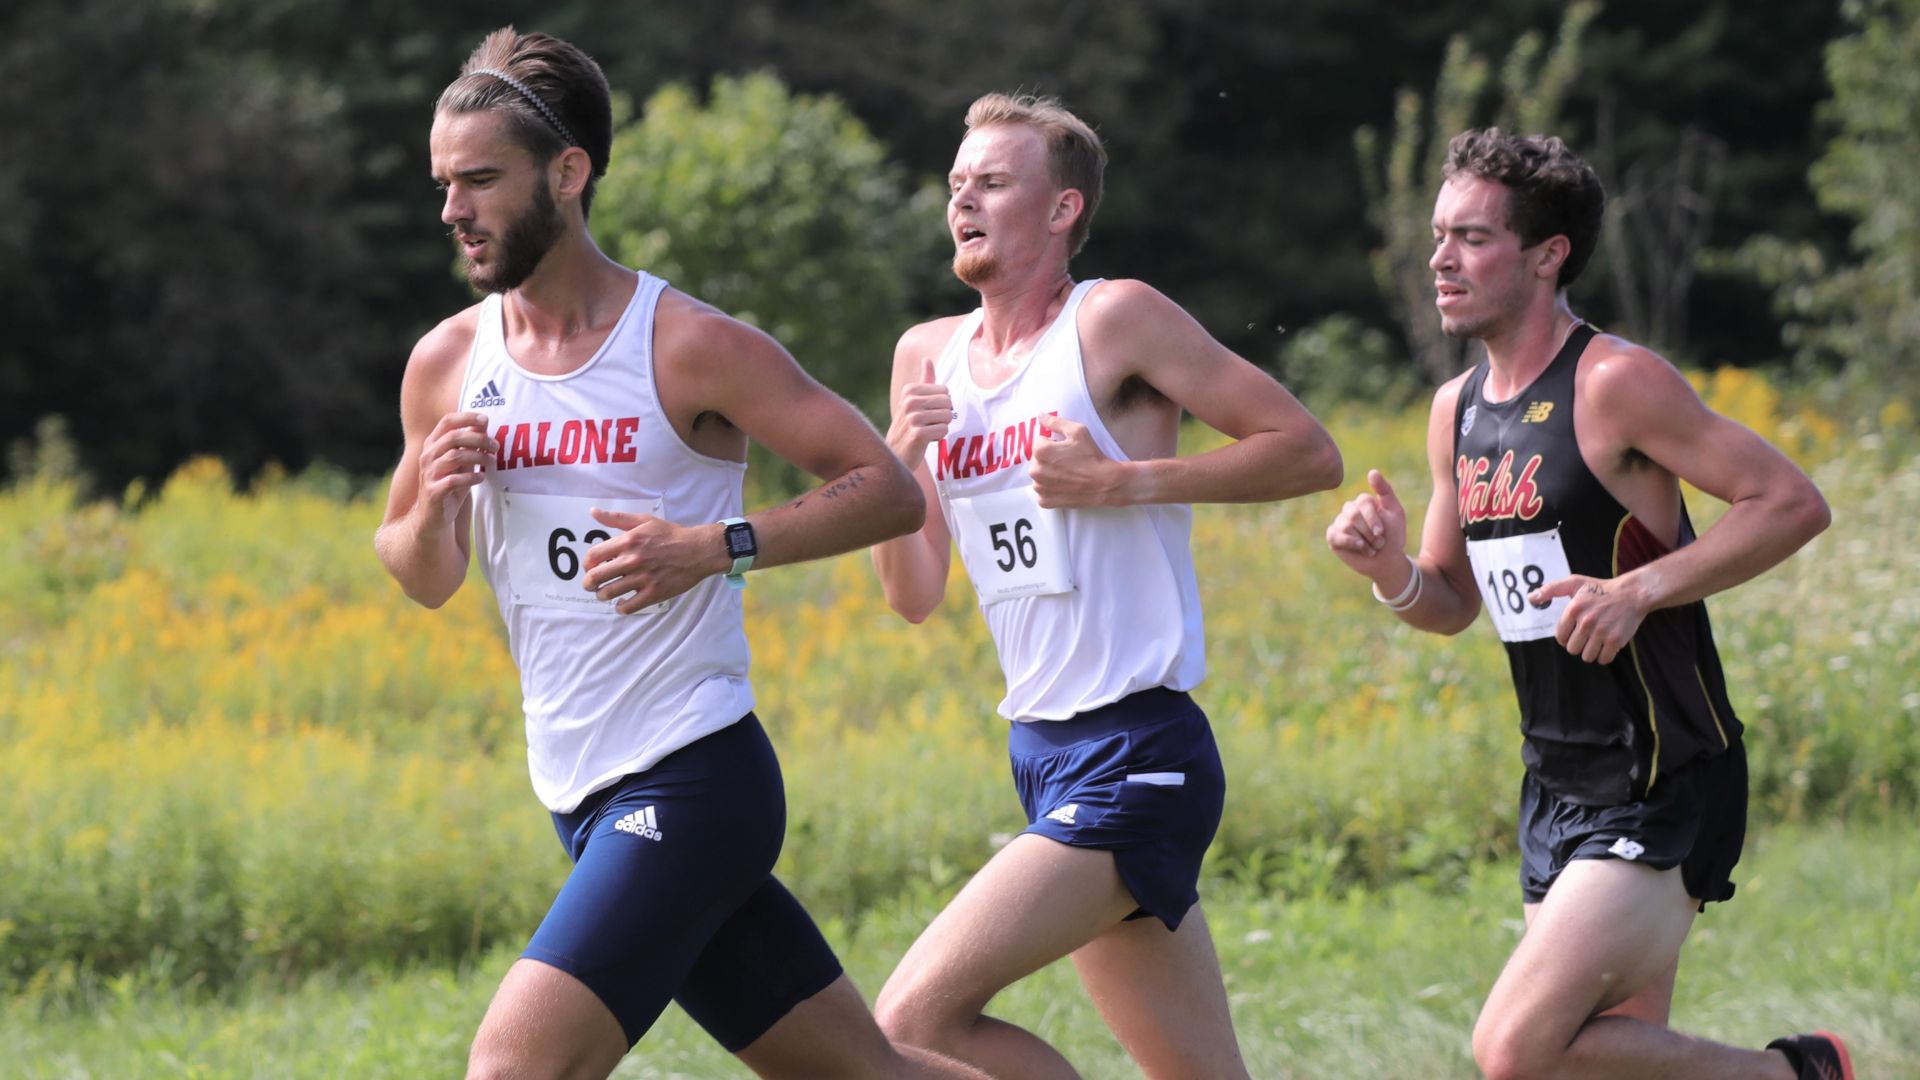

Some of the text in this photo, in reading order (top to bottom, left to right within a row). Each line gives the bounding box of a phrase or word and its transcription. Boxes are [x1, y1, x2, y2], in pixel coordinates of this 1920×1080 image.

[470, 397, 506, 409] adidas
[1457, 449, 1543, 529] Walsh
[989, 518, 1037, 572] 56
[1488, 564, 1553, 615] 188
[614, 819, 663, 841] adidas
